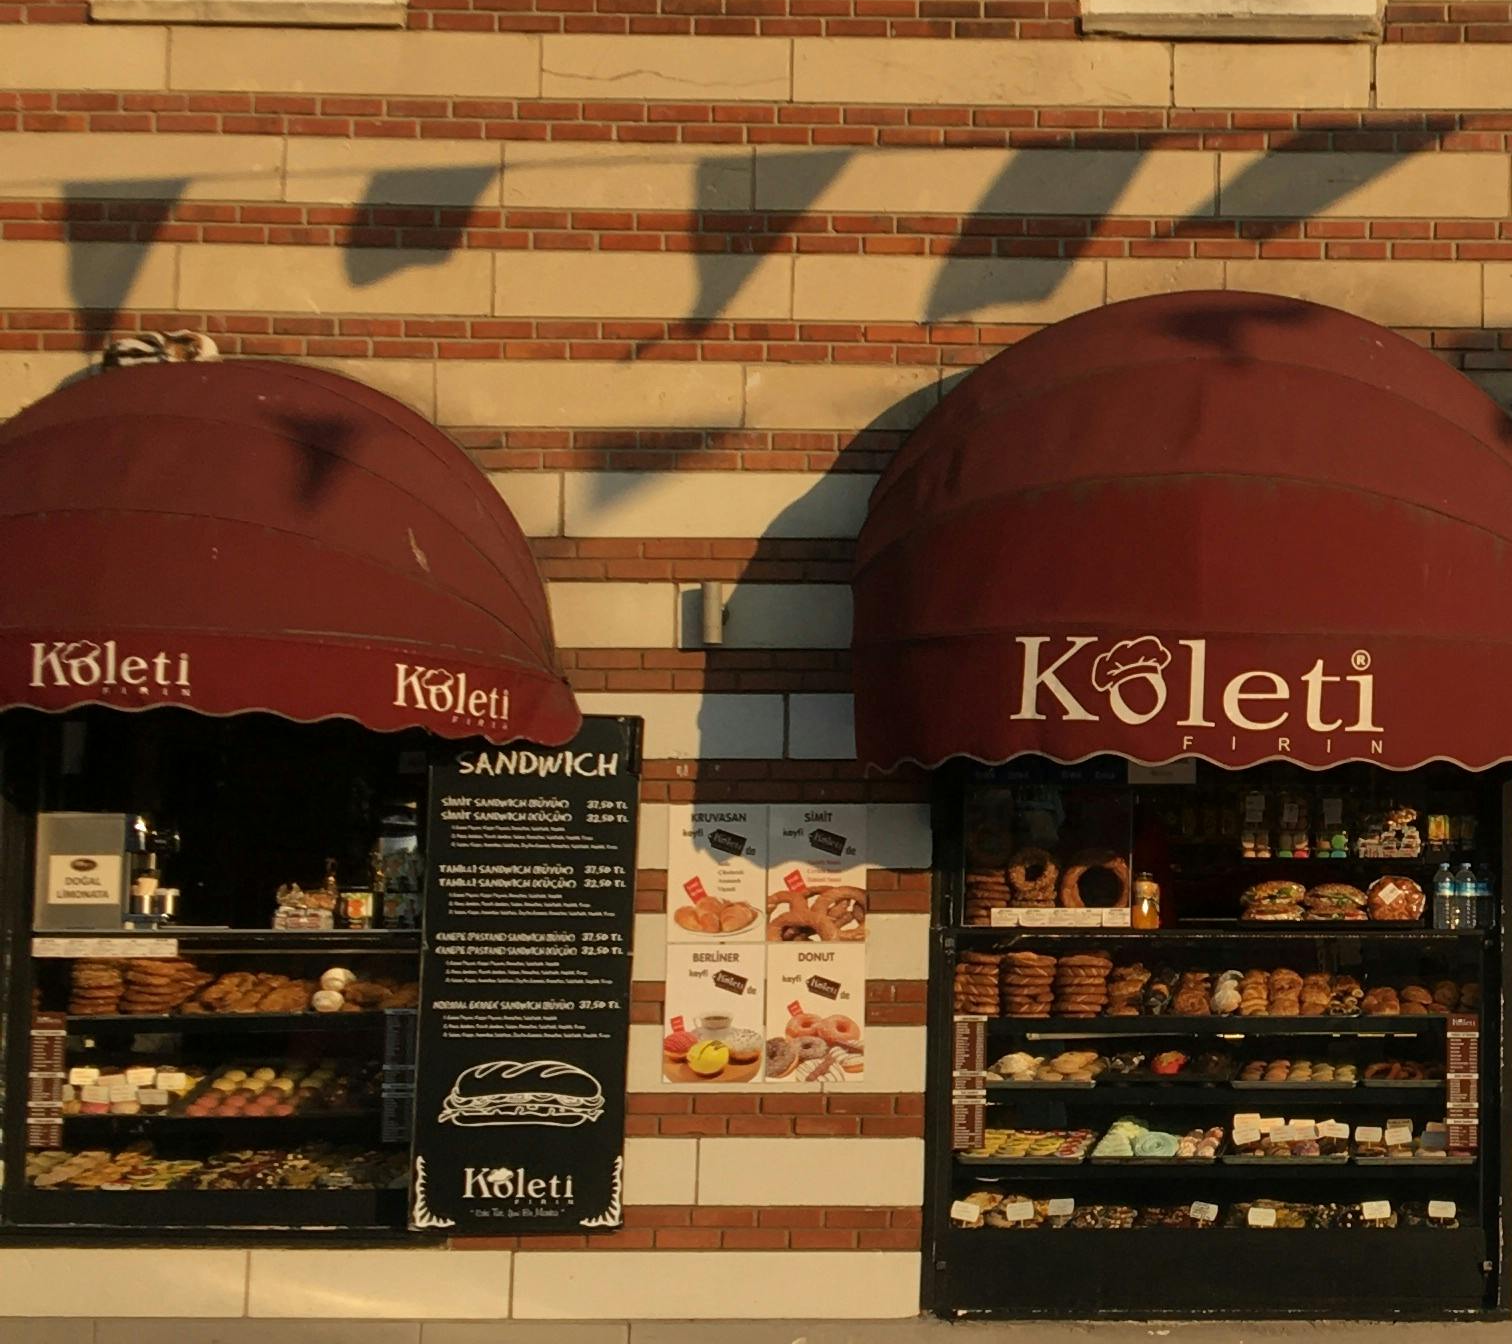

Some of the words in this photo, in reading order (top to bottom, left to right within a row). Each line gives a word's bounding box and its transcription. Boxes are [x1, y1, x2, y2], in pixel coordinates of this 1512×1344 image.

[1182, 735, 1384, 755] FIRIN
[457, 751, 619, 777] SANDWICH
[691, 813, 747, 823] KRUVASAN
[804, 810, 832, 823] SİMİT
[692, 950, 740, 963] BERLİNER
[798, 952, 835, 962] DONUT
